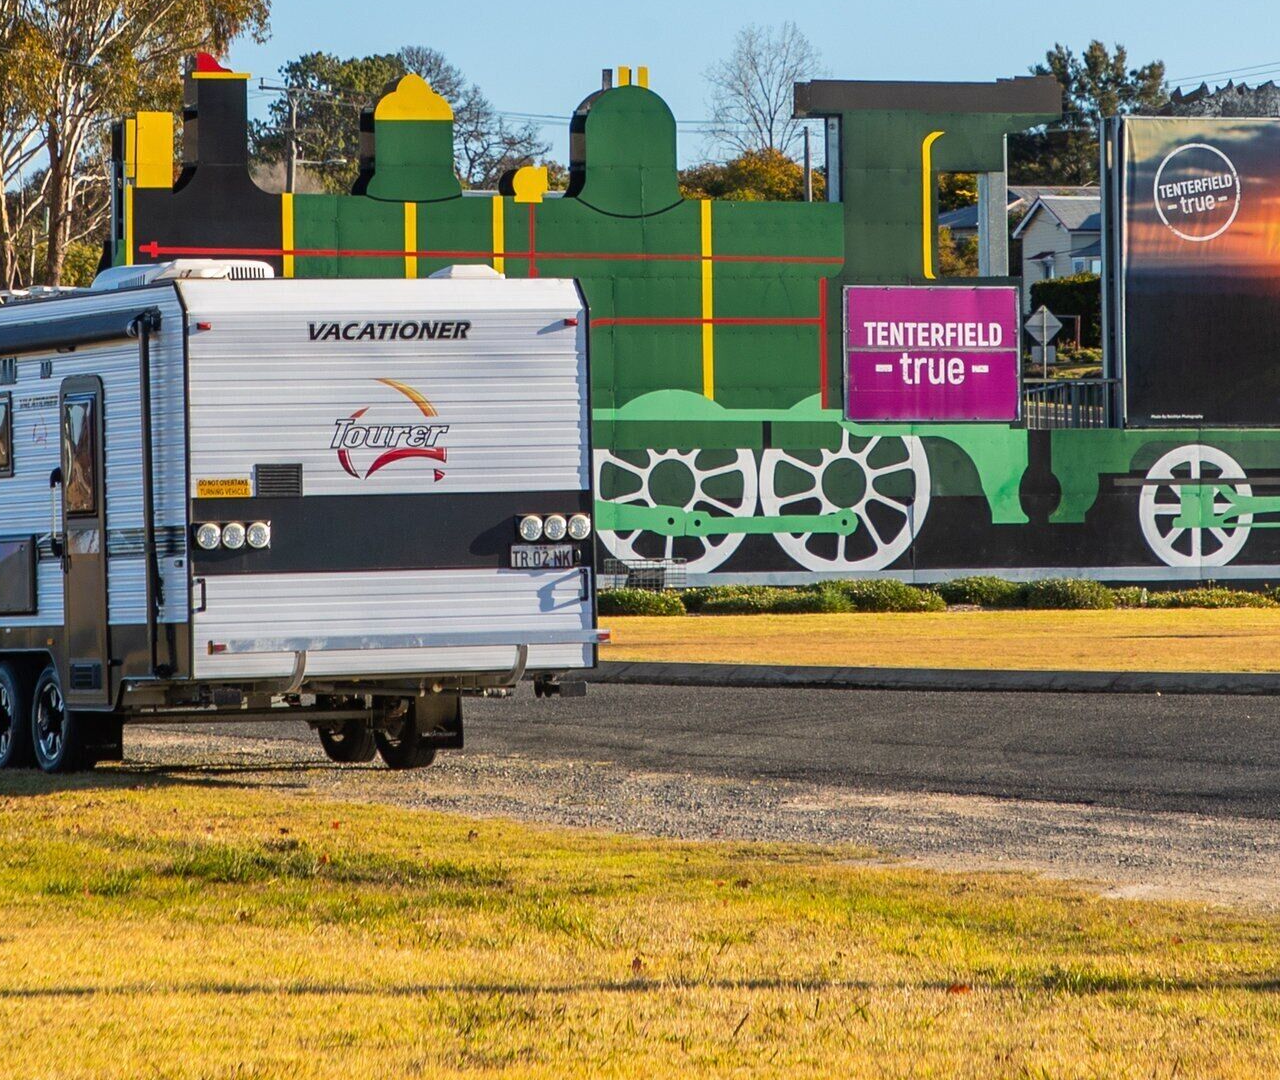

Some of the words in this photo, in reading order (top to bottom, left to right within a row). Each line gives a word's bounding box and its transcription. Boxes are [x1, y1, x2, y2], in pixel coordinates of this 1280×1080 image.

[1159, 173, 1233, 199] TENTERFIELD
[308, 321, 471, 341] VACATIONER
[863, 321, 1003, 348] TENTERFIELD
[198, 479, 207, 487] DO
[207, 479, 218, 487] NOT
[219, 479, 249, 487] OVERTAKE
[200, 488, 224, 496] TURNING
[224, 488, 248, 496] VEHICLE
